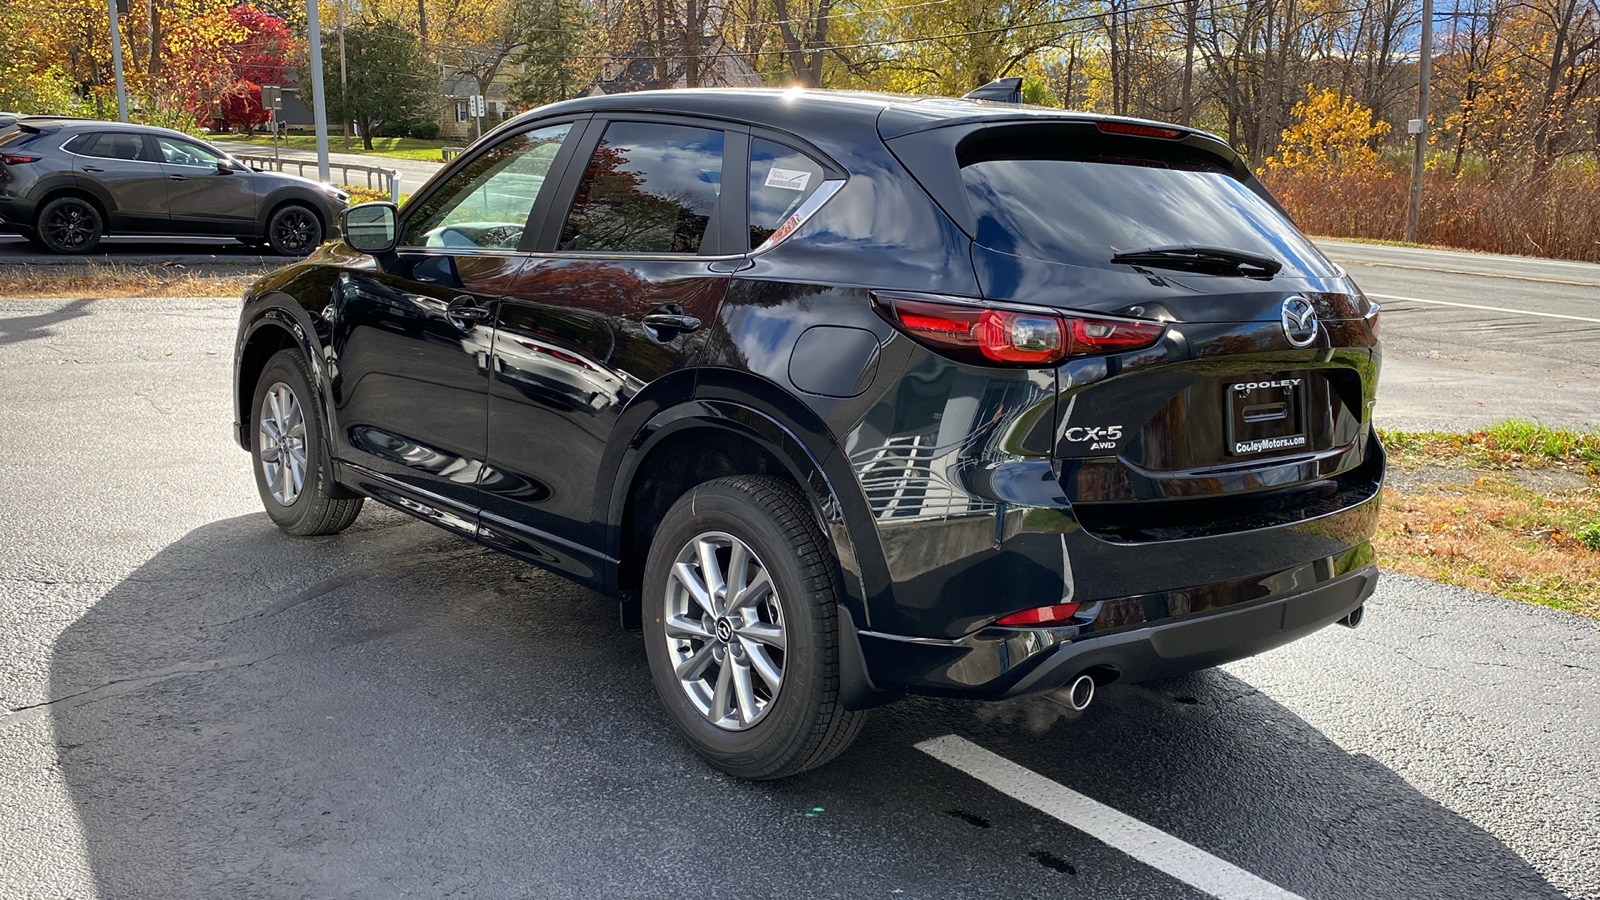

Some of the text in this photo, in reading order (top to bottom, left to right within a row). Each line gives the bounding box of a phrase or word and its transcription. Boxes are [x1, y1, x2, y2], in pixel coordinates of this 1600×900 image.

[1234, 378, 1301, 390] COOLEY
[1065, 425, 1123, 442] CX-5
[1090, 441, 1116, 450] AWD
[1236, 436, 1305, 453] CooleyMotors.com
